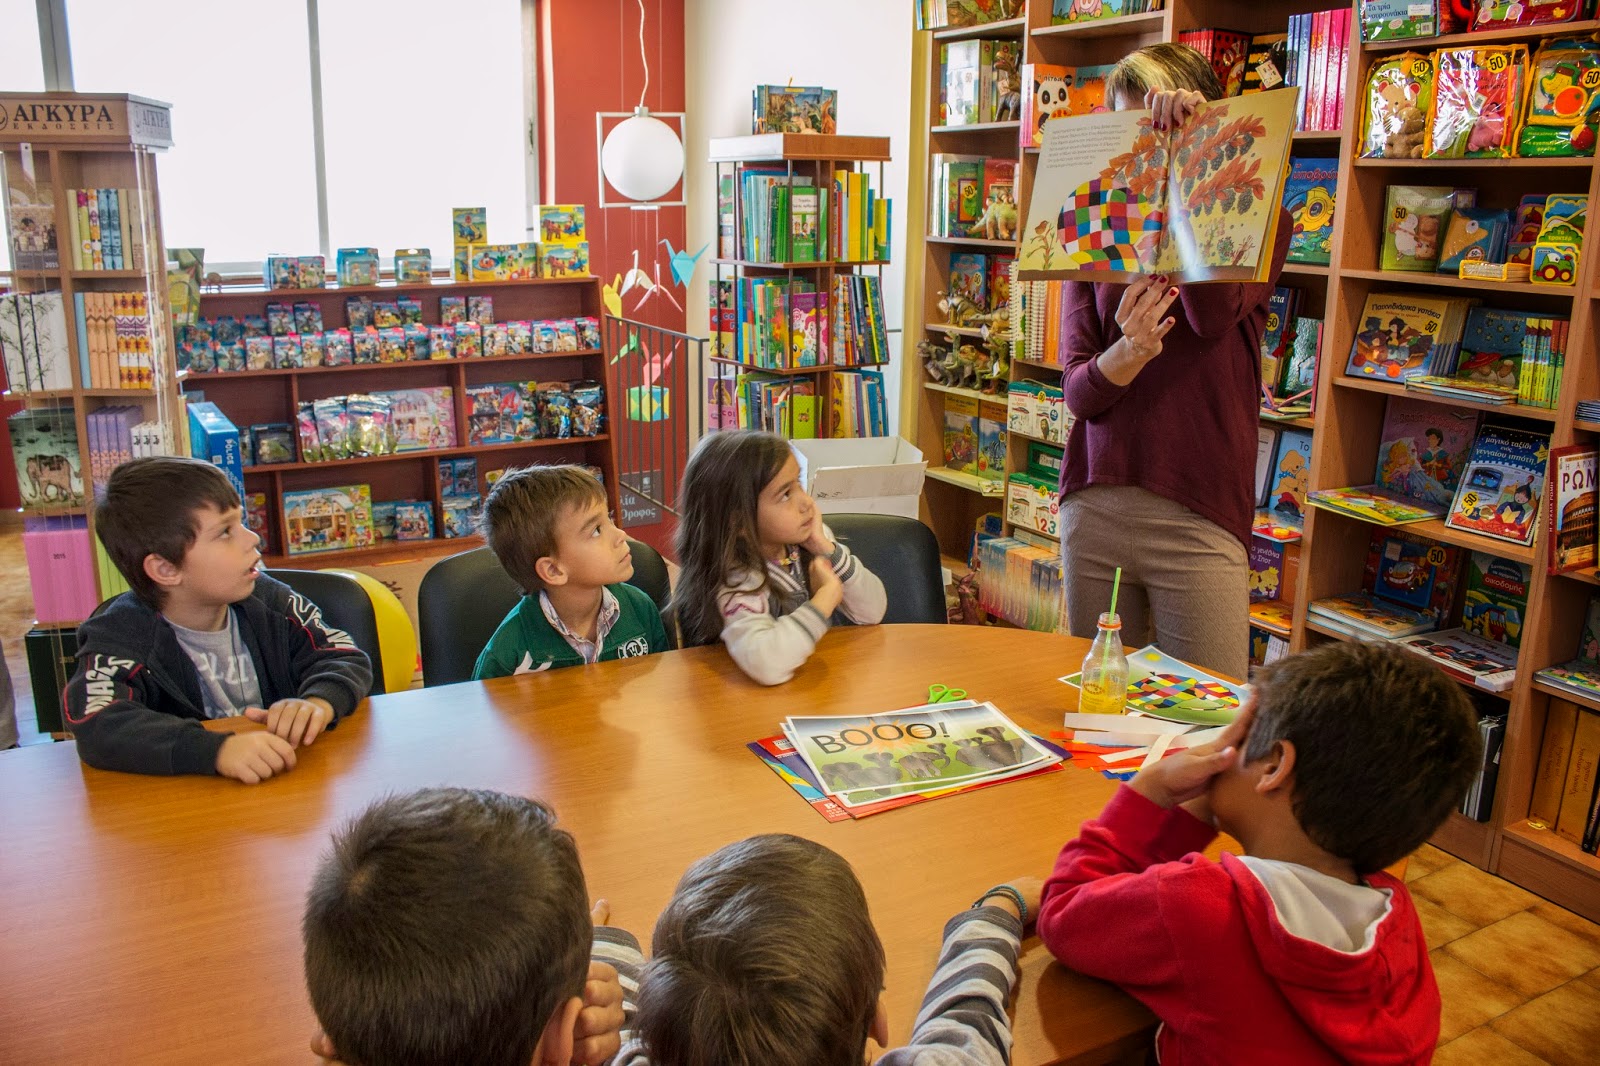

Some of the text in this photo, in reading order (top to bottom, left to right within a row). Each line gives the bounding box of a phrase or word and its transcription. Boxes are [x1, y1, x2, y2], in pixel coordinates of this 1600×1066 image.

[13, 103, 113, 122] ΑΓΚΥΡΑ
[13, 122, 115, 130] ΕΚΔΟΣΕΙΣ
[1485, 436, 1510, 446] μαγικό
[1561, 468, 1598, 493] ΡΩΜ
[1484, 576, 1524, 595] οικοδομής
[811, 721, 951, 755] BOOO!
